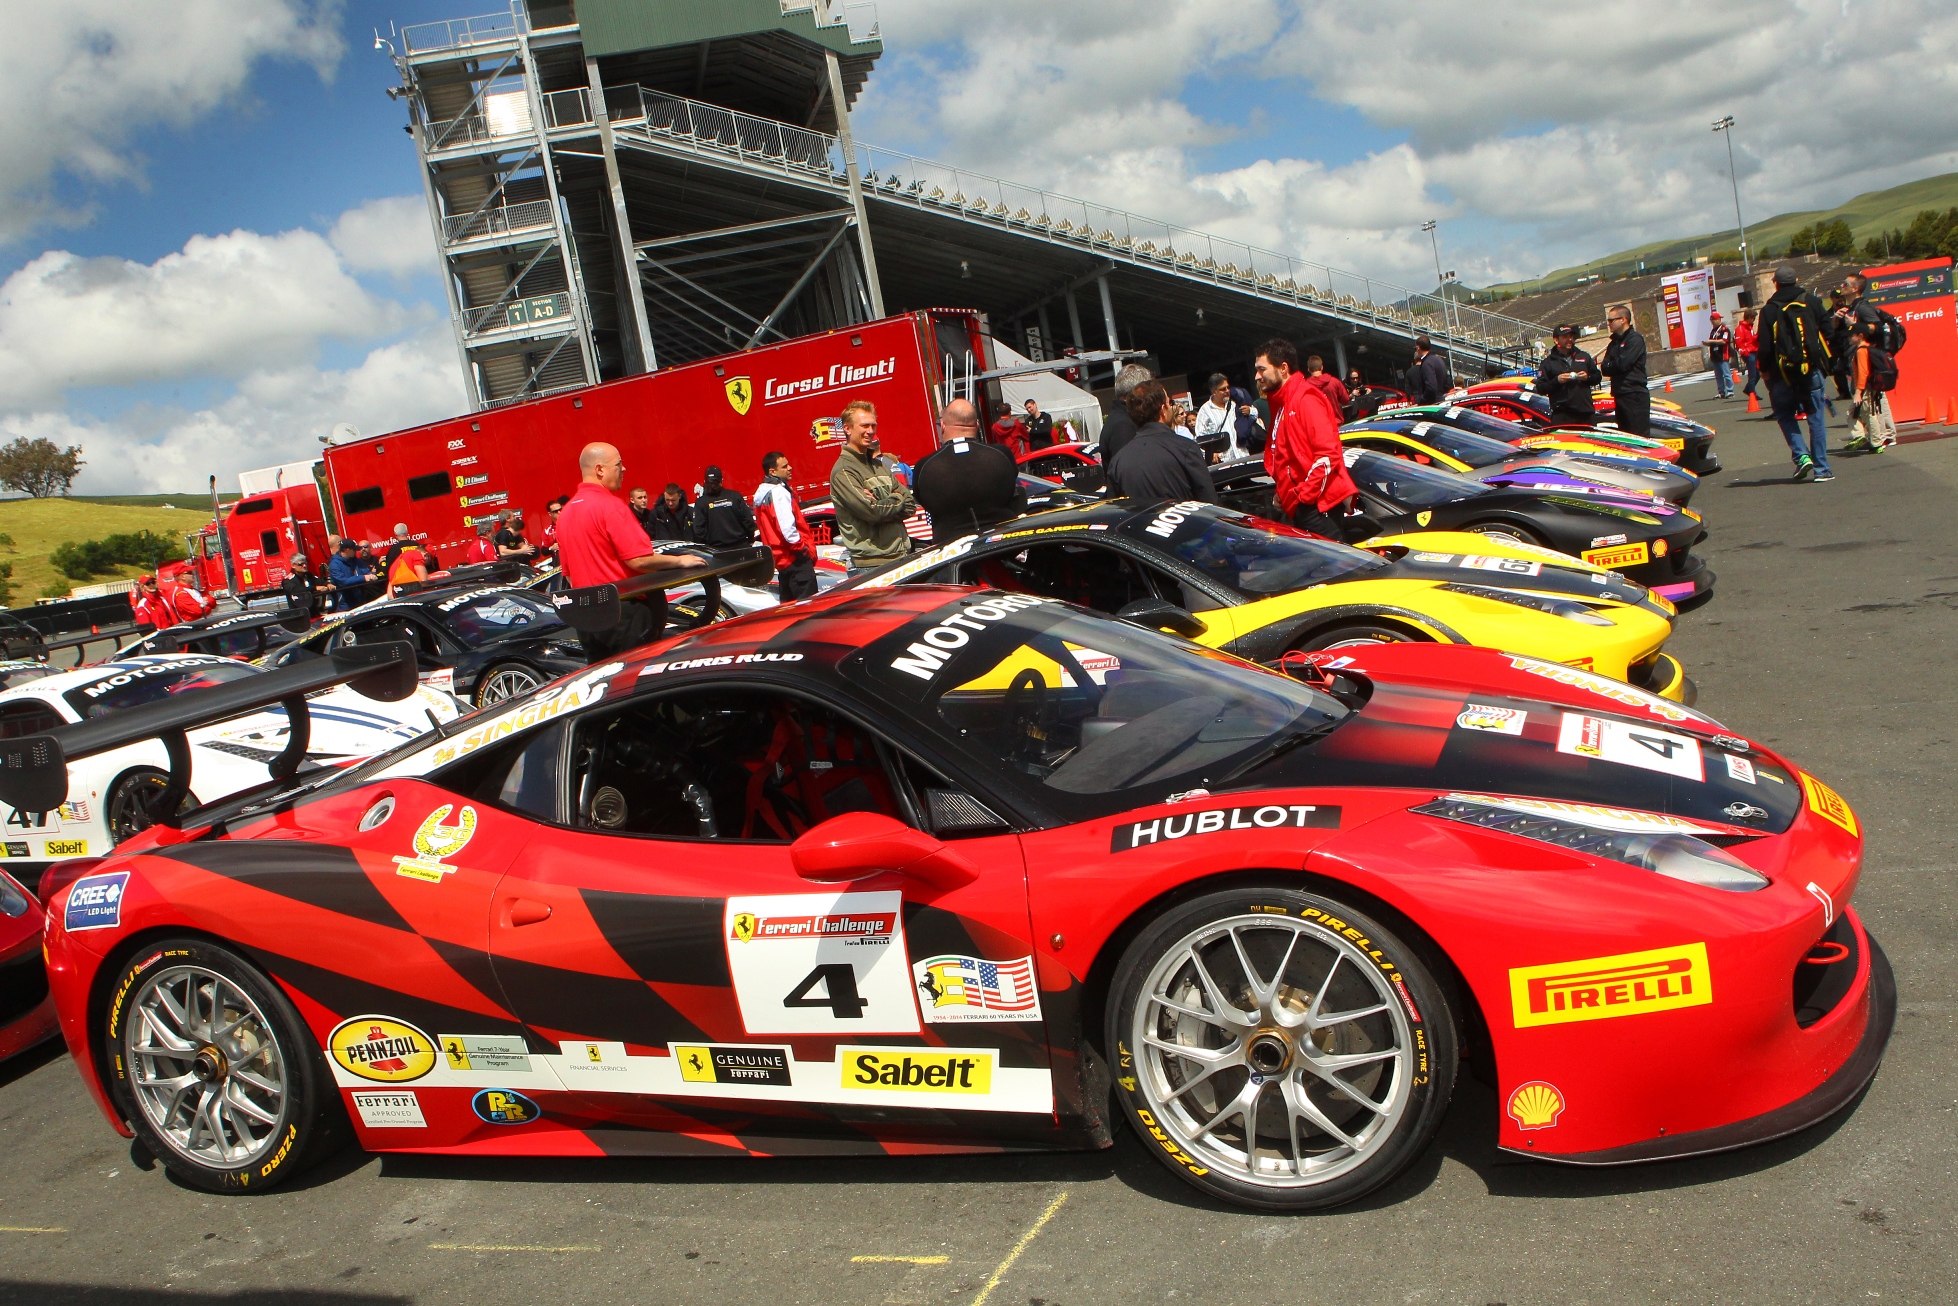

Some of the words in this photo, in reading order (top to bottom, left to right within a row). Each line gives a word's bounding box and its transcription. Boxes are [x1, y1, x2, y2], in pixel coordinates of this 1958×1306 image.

[532, 298, 552, 306] SECTION
[534, 305, 554, 318] A-D
[514, 311, 520, 321] 1
[1906, 308, 1944, 322] Fermé
[764, 376, 824, 400] Corse
[828, 356, 896, 386] Clienti
[447, 439, 464, 449] FXX
[468, 496, 485, 505] Ferrari
[1002, 529, 1034, 539] ROSS
[883, 547, 960, 586] SINGHA
[1587, 548, 1642, 566] PIRELLI
[667, 654, 733, 672] CHRIS
[734, 653, 805, 665] RUUD
[83, 655, 237, 698] MOTOROLA
[1513, 658, 1646, 707] SINGHA
[460, 691, 581, 755] SINGHA
[1628, 732, 1684, 759] 4
[1809, 778, 1848, 827] PIRELLI
[1504, 796, 1704, 831] SINGHA
[1131, 805, 1317, 848] HUBLOT
[48, 842, 83, 855] Sabelt
[400, 866, 417, 874] Ferrari
[416, 870, 439, 880] Challenge
[70, 884, 109, 907] CREE
[87, 908, 99, 916] LED
[100, 906, 117, 916] Light
[757, 917, 811, 935] Ferrari
[813, 915, 884, 935] Challenge
[860, 937, 890, 946] PIRELLI
[1301, 908, 1395, 970] PIRELLI
[783, 963, 869, 1019] 4
[1528, 958, 1693, 1014] PIRELLI
[110, 970, 135, 1039] PIRELLI
[346, 1036, 420, 1064] PENNZOIL
[1415, 1029, 1426, 1050] RACE
[468, 1053, 490, 1061] Genuine
[489, 1053, 524, 1061] Maintenance
[716, 1054, 783, 1067] GENUINE
[1419, 1051, 1428, 1073] TYRE
[569, 1064, 600, 1072] FINANCIAL
[730, 1068, 770, 1080] Ferrari
[855, 1053, 975, 1088] Sabelt
[356, 1094, 417, 1107] Ferrari
[261, 1123, 298, 1177] PZERO
[1137, 1109, 1209, 1176] PZERO
